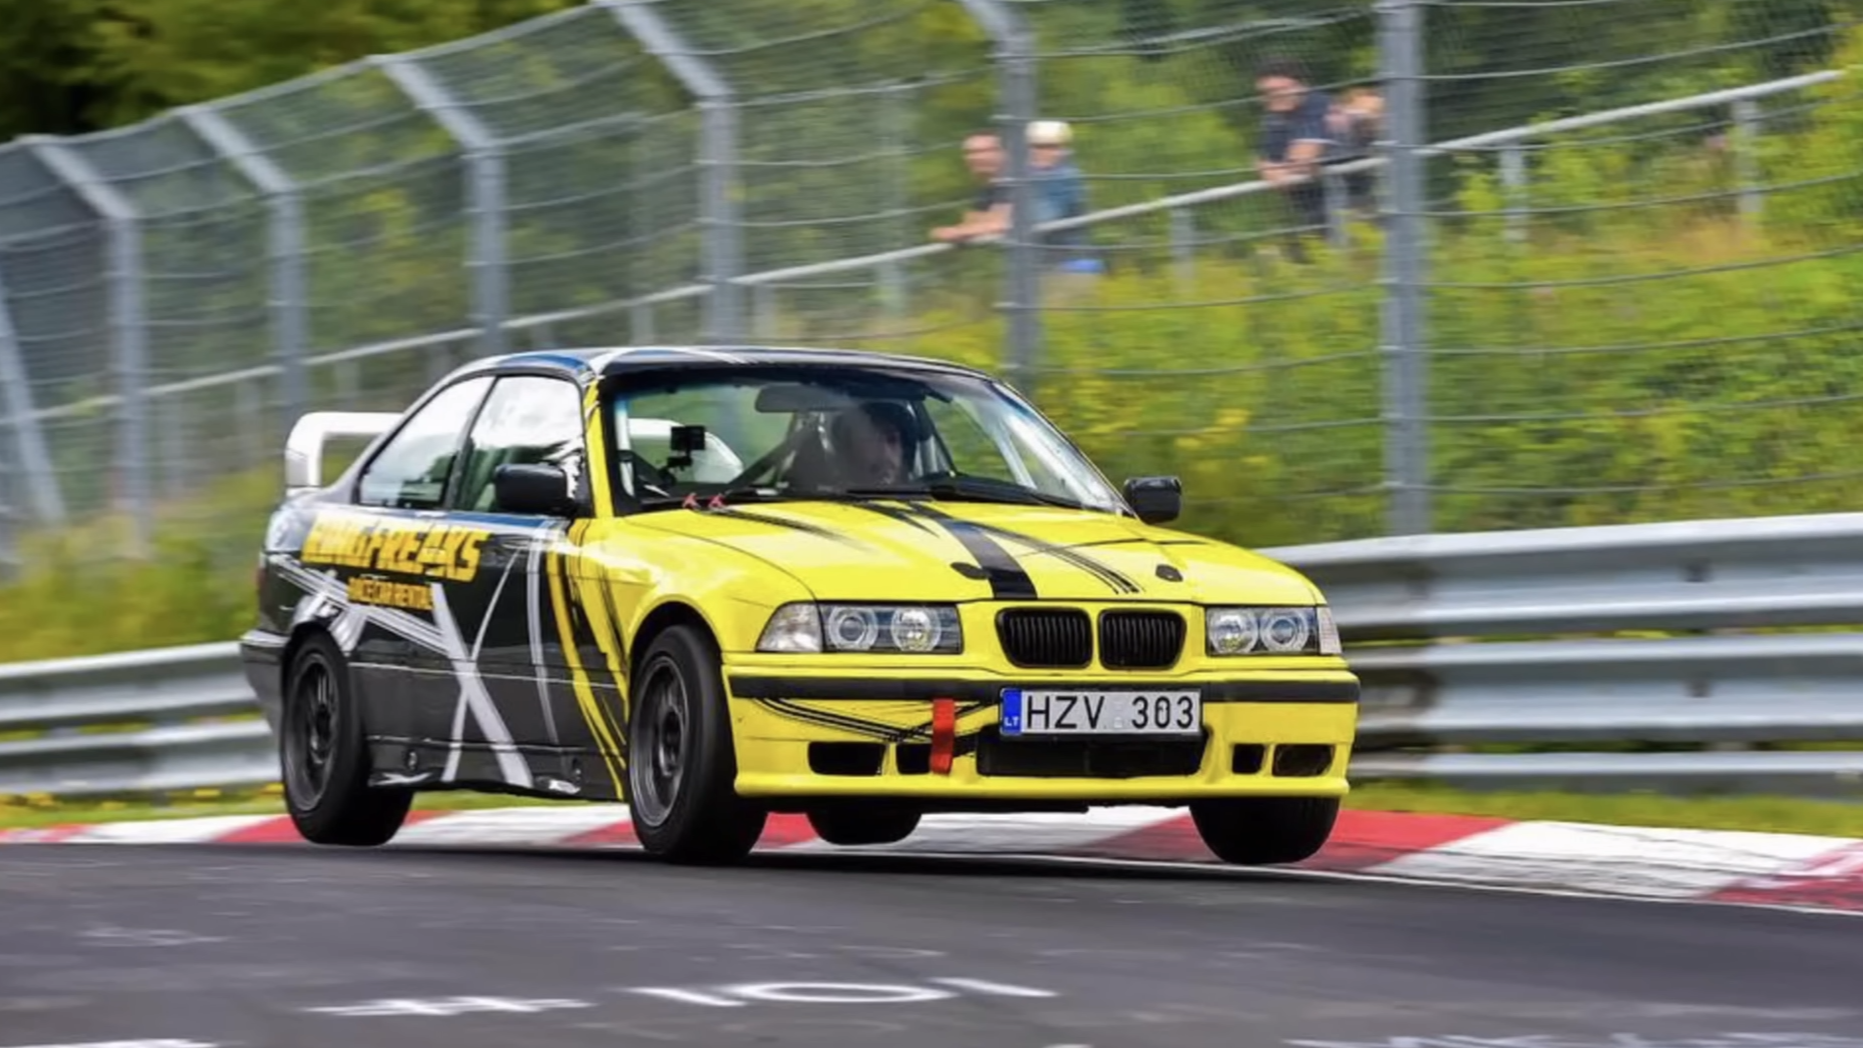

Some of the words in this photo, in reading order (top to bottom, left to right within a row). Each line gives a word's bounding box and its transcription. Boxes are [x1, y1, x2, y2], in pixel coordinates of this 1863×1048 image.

[1004, 716, 1019, 727] LT
[1027, 695, 1104, 730] HZV
[1132, 695, 1194, 729] 303
